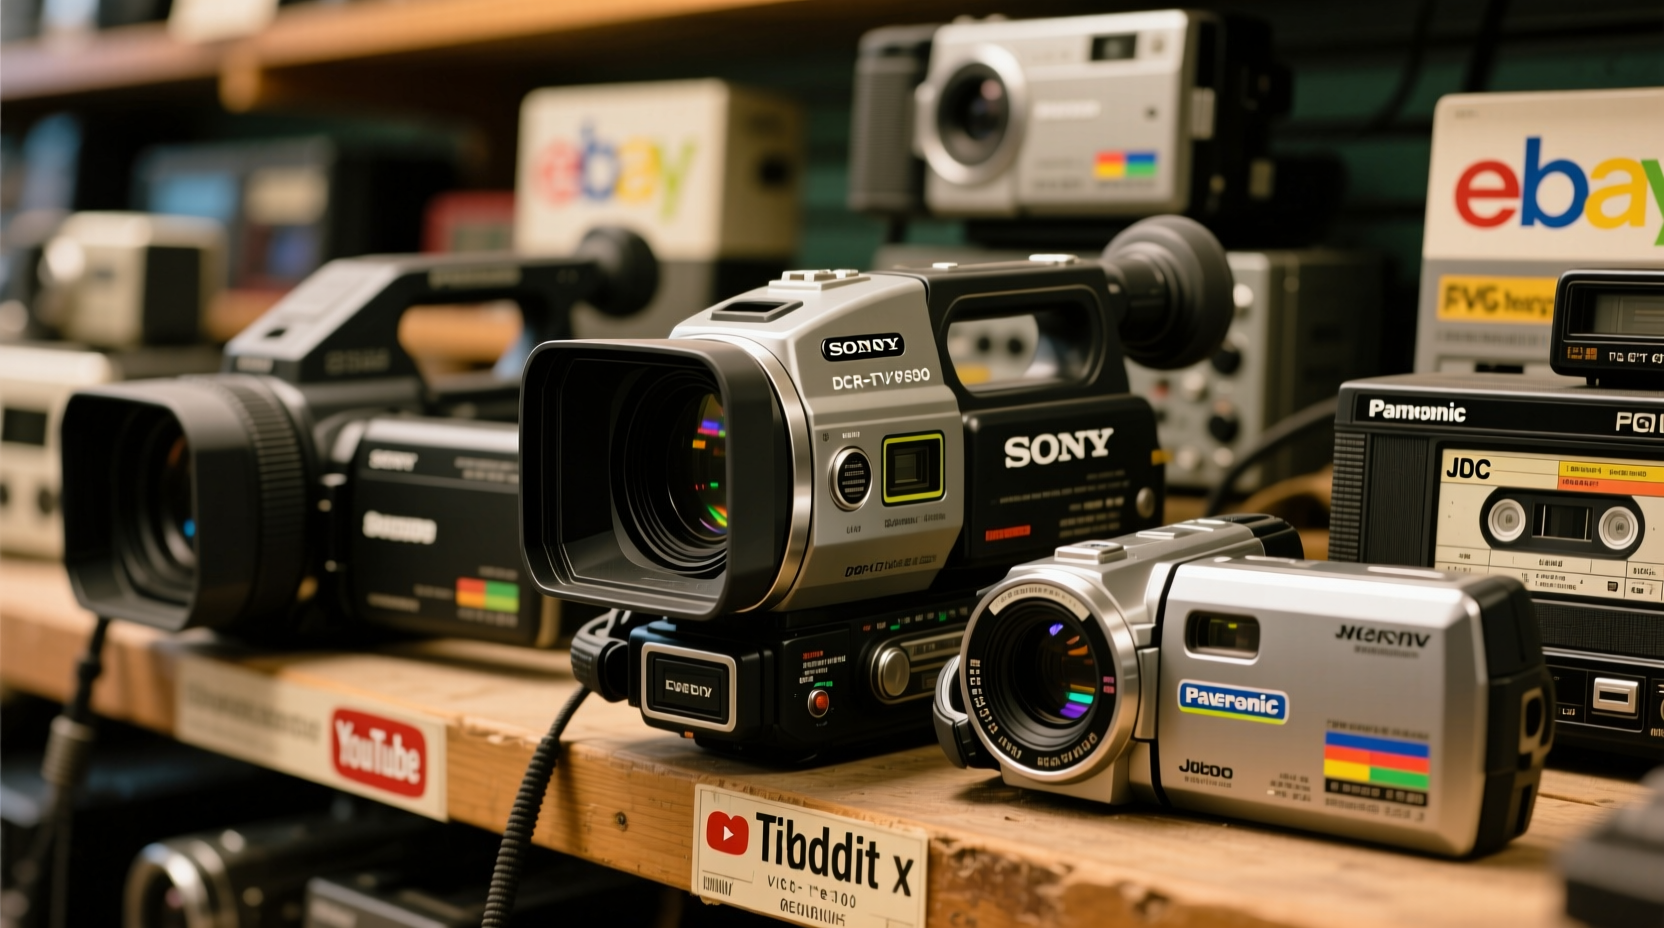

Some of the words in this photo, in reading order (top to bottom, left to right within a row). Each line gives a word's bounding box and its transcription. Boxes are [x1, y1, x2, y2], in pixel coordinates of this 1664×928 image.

[531, 117, 699, 222] ebay
[1004, 427, 1115, 469] SONY
[1446, 456, 1492, 480] JDC
[335, 718, 421, 785] YouTube
[755, 811, 881, 890] Tibddit
